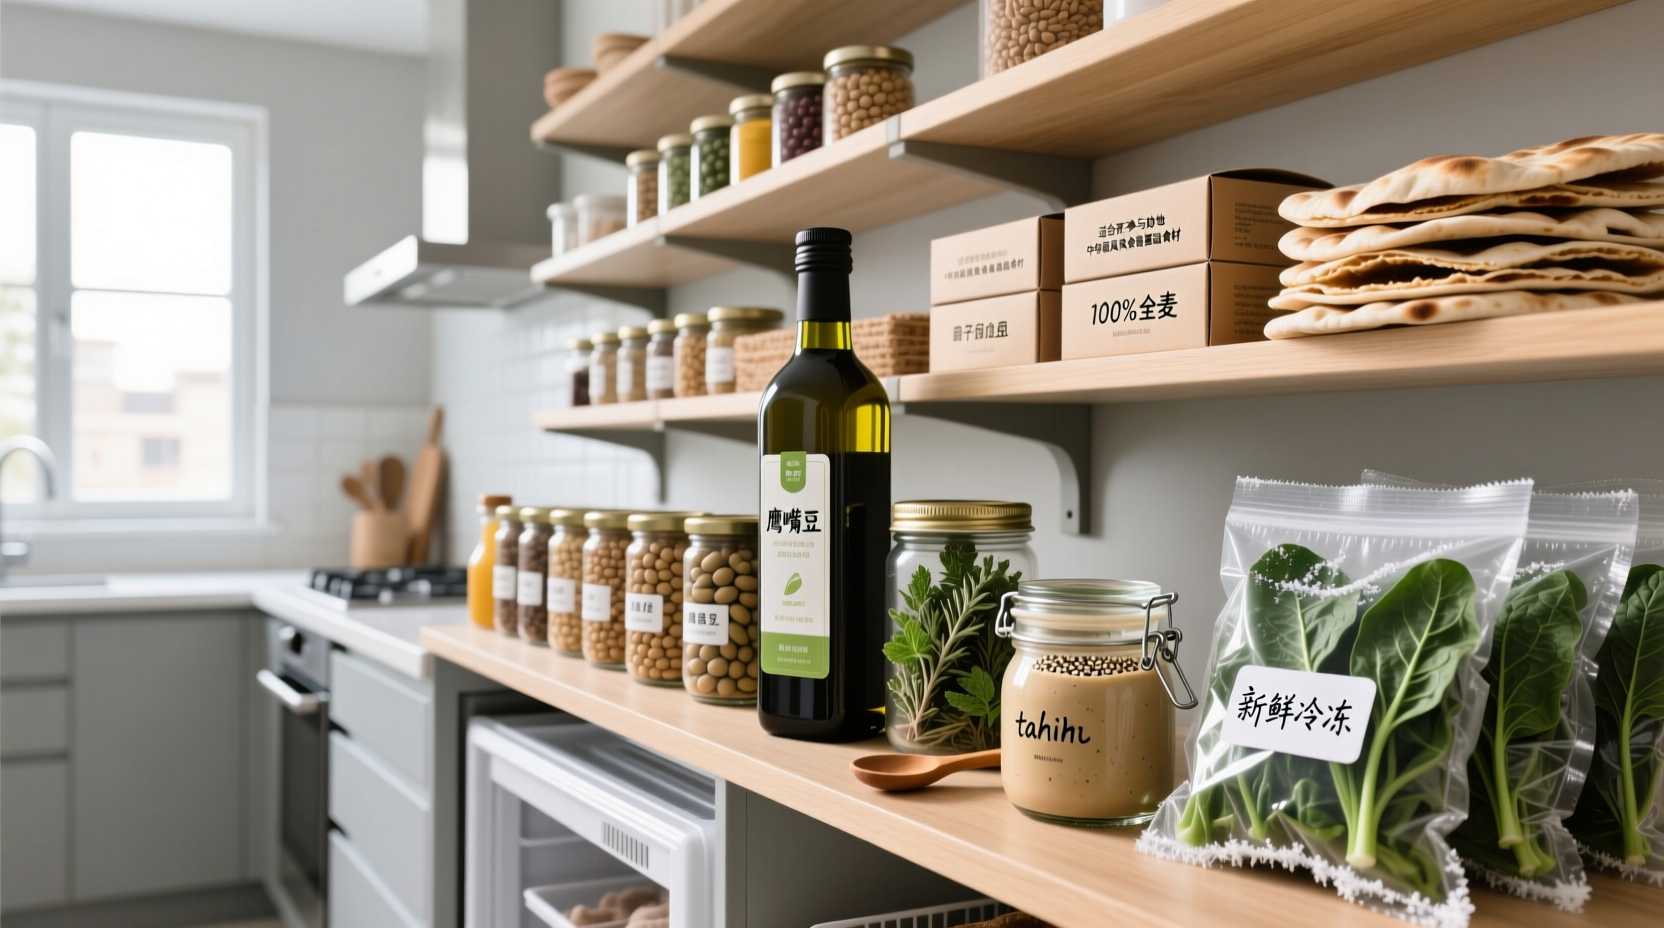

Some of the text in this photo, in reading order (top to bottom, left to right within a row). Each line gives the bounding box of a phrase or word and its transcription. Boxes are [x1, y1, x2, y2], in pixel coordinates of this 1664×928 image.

[1091, 290, 1178, 325] 100%全麦
[766, 506, 822, 534] 鹰嘴豆
[1237, 685, 1353, 736] 新鲜冷冻
